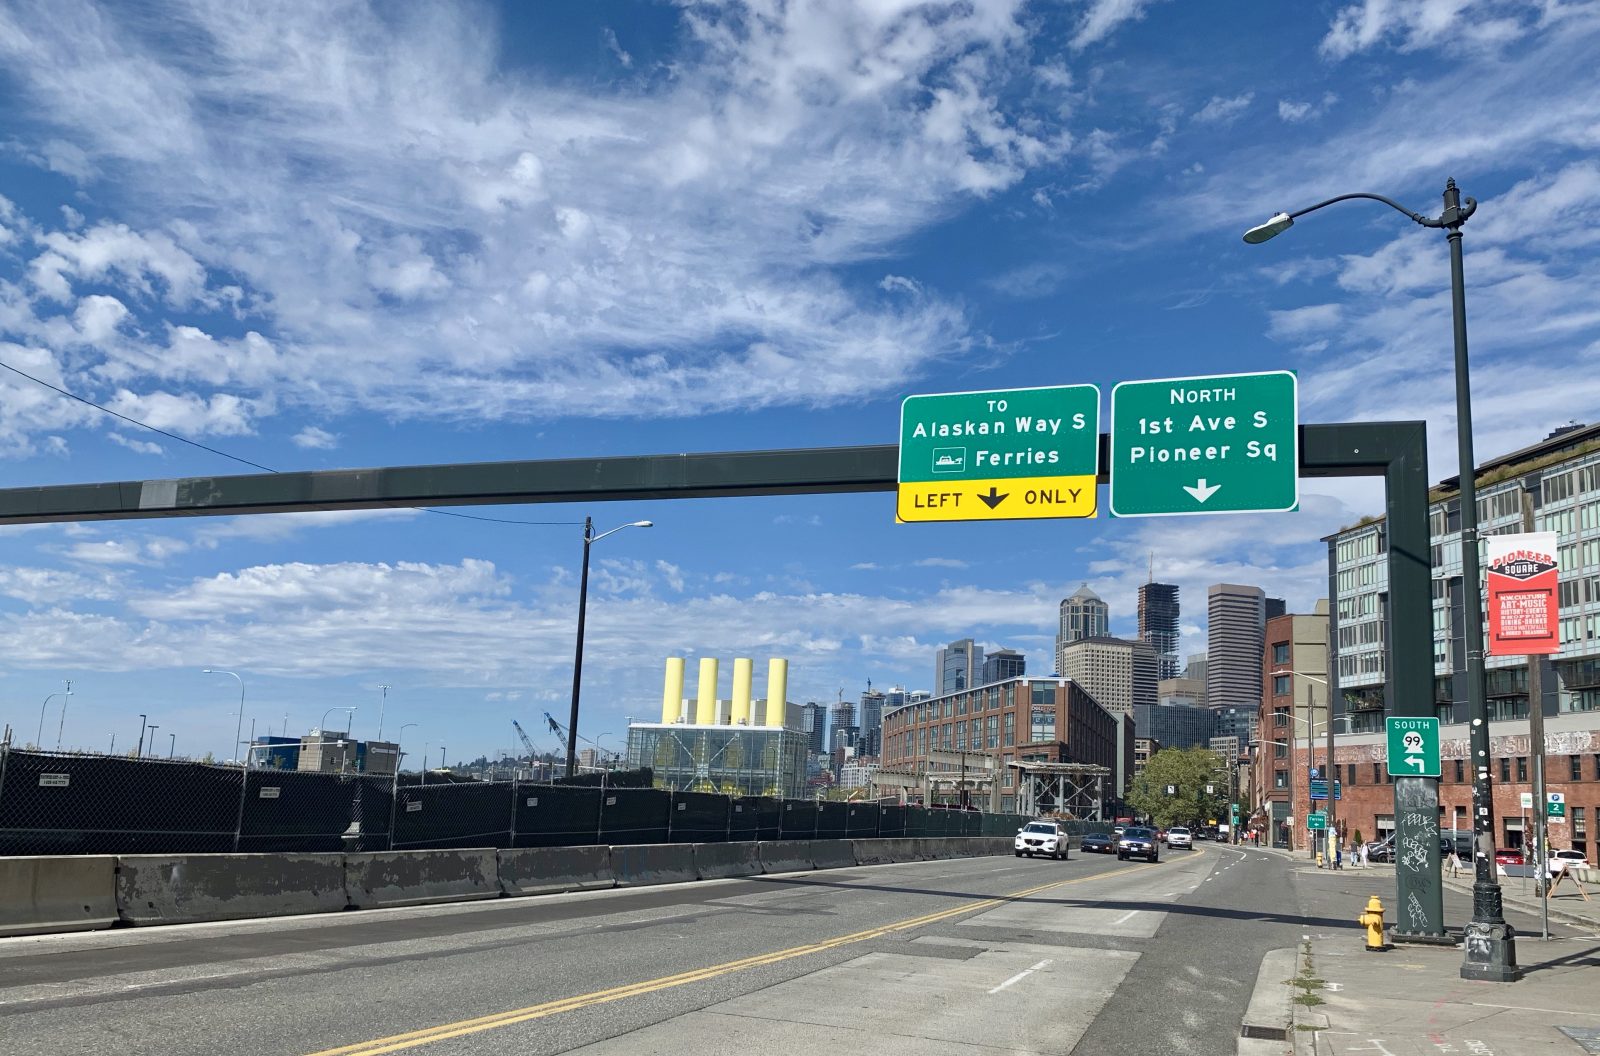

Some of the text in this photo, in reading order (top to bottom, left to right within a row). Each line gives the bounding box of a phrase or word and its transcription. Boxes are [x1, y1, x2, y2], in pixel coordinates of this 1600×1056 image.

[1170, 388, 1236, 405] NORTH
[986, 400, 1008, 413] TO
[912, 413, 1086, 438] Alaskan Way S
[1139, 411, 1268, 434] 1st Ave S
[976, 447, 1059, 467] Ferries
[1130, 440, 1277, 464] Pioneer Sq
[914, 488, 1082, 508] LEFT ONLY
[1493, 549, 1552, 570] PIONEER
[1504, 563, 1539, 575] SQUARE
[1394, 720, 1430, 730] SOUTH
[1405, 736, 1420, 747] 99
[1553, 803, 1560, 811] 2
